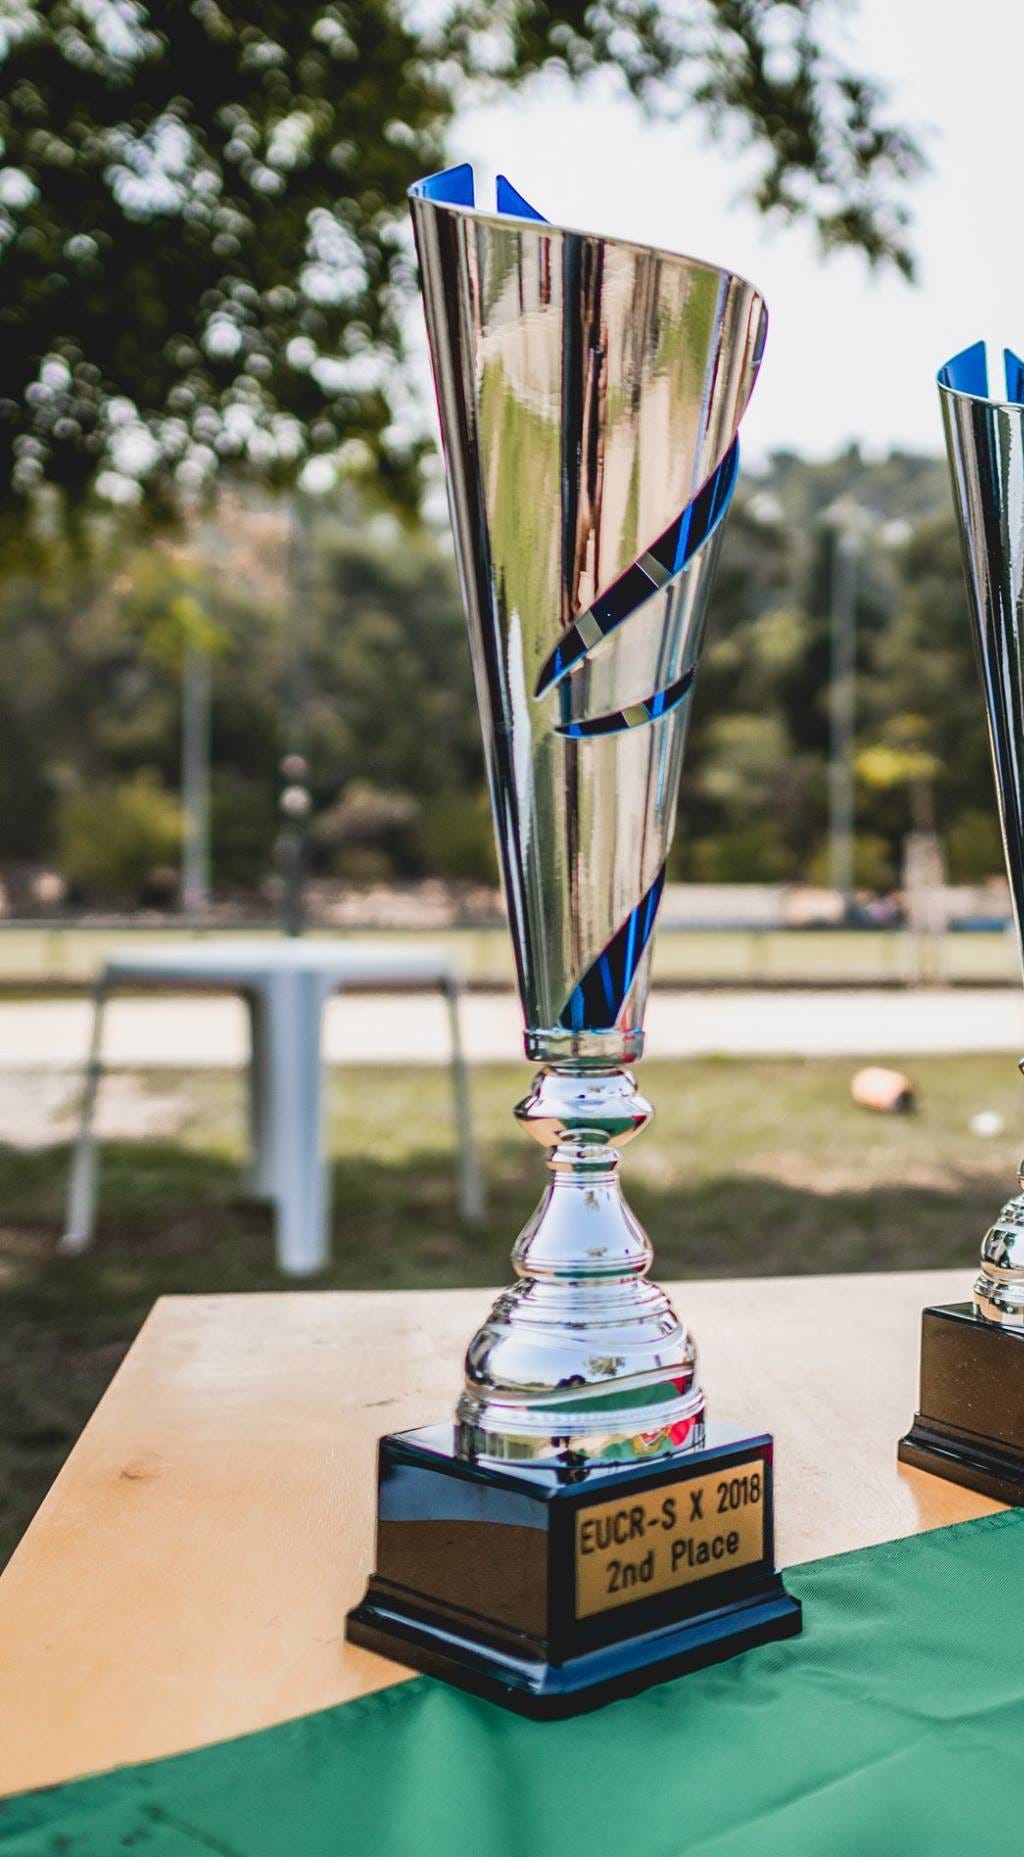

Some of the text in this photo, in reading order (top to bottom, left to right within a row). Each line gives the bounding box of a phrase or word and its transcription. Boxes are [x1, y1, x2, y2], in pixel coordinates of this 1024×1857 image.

[580, 1473, 761, 1555] EUCR-S X 2018
[607, 1530, 740, 1594] 2nd Place
